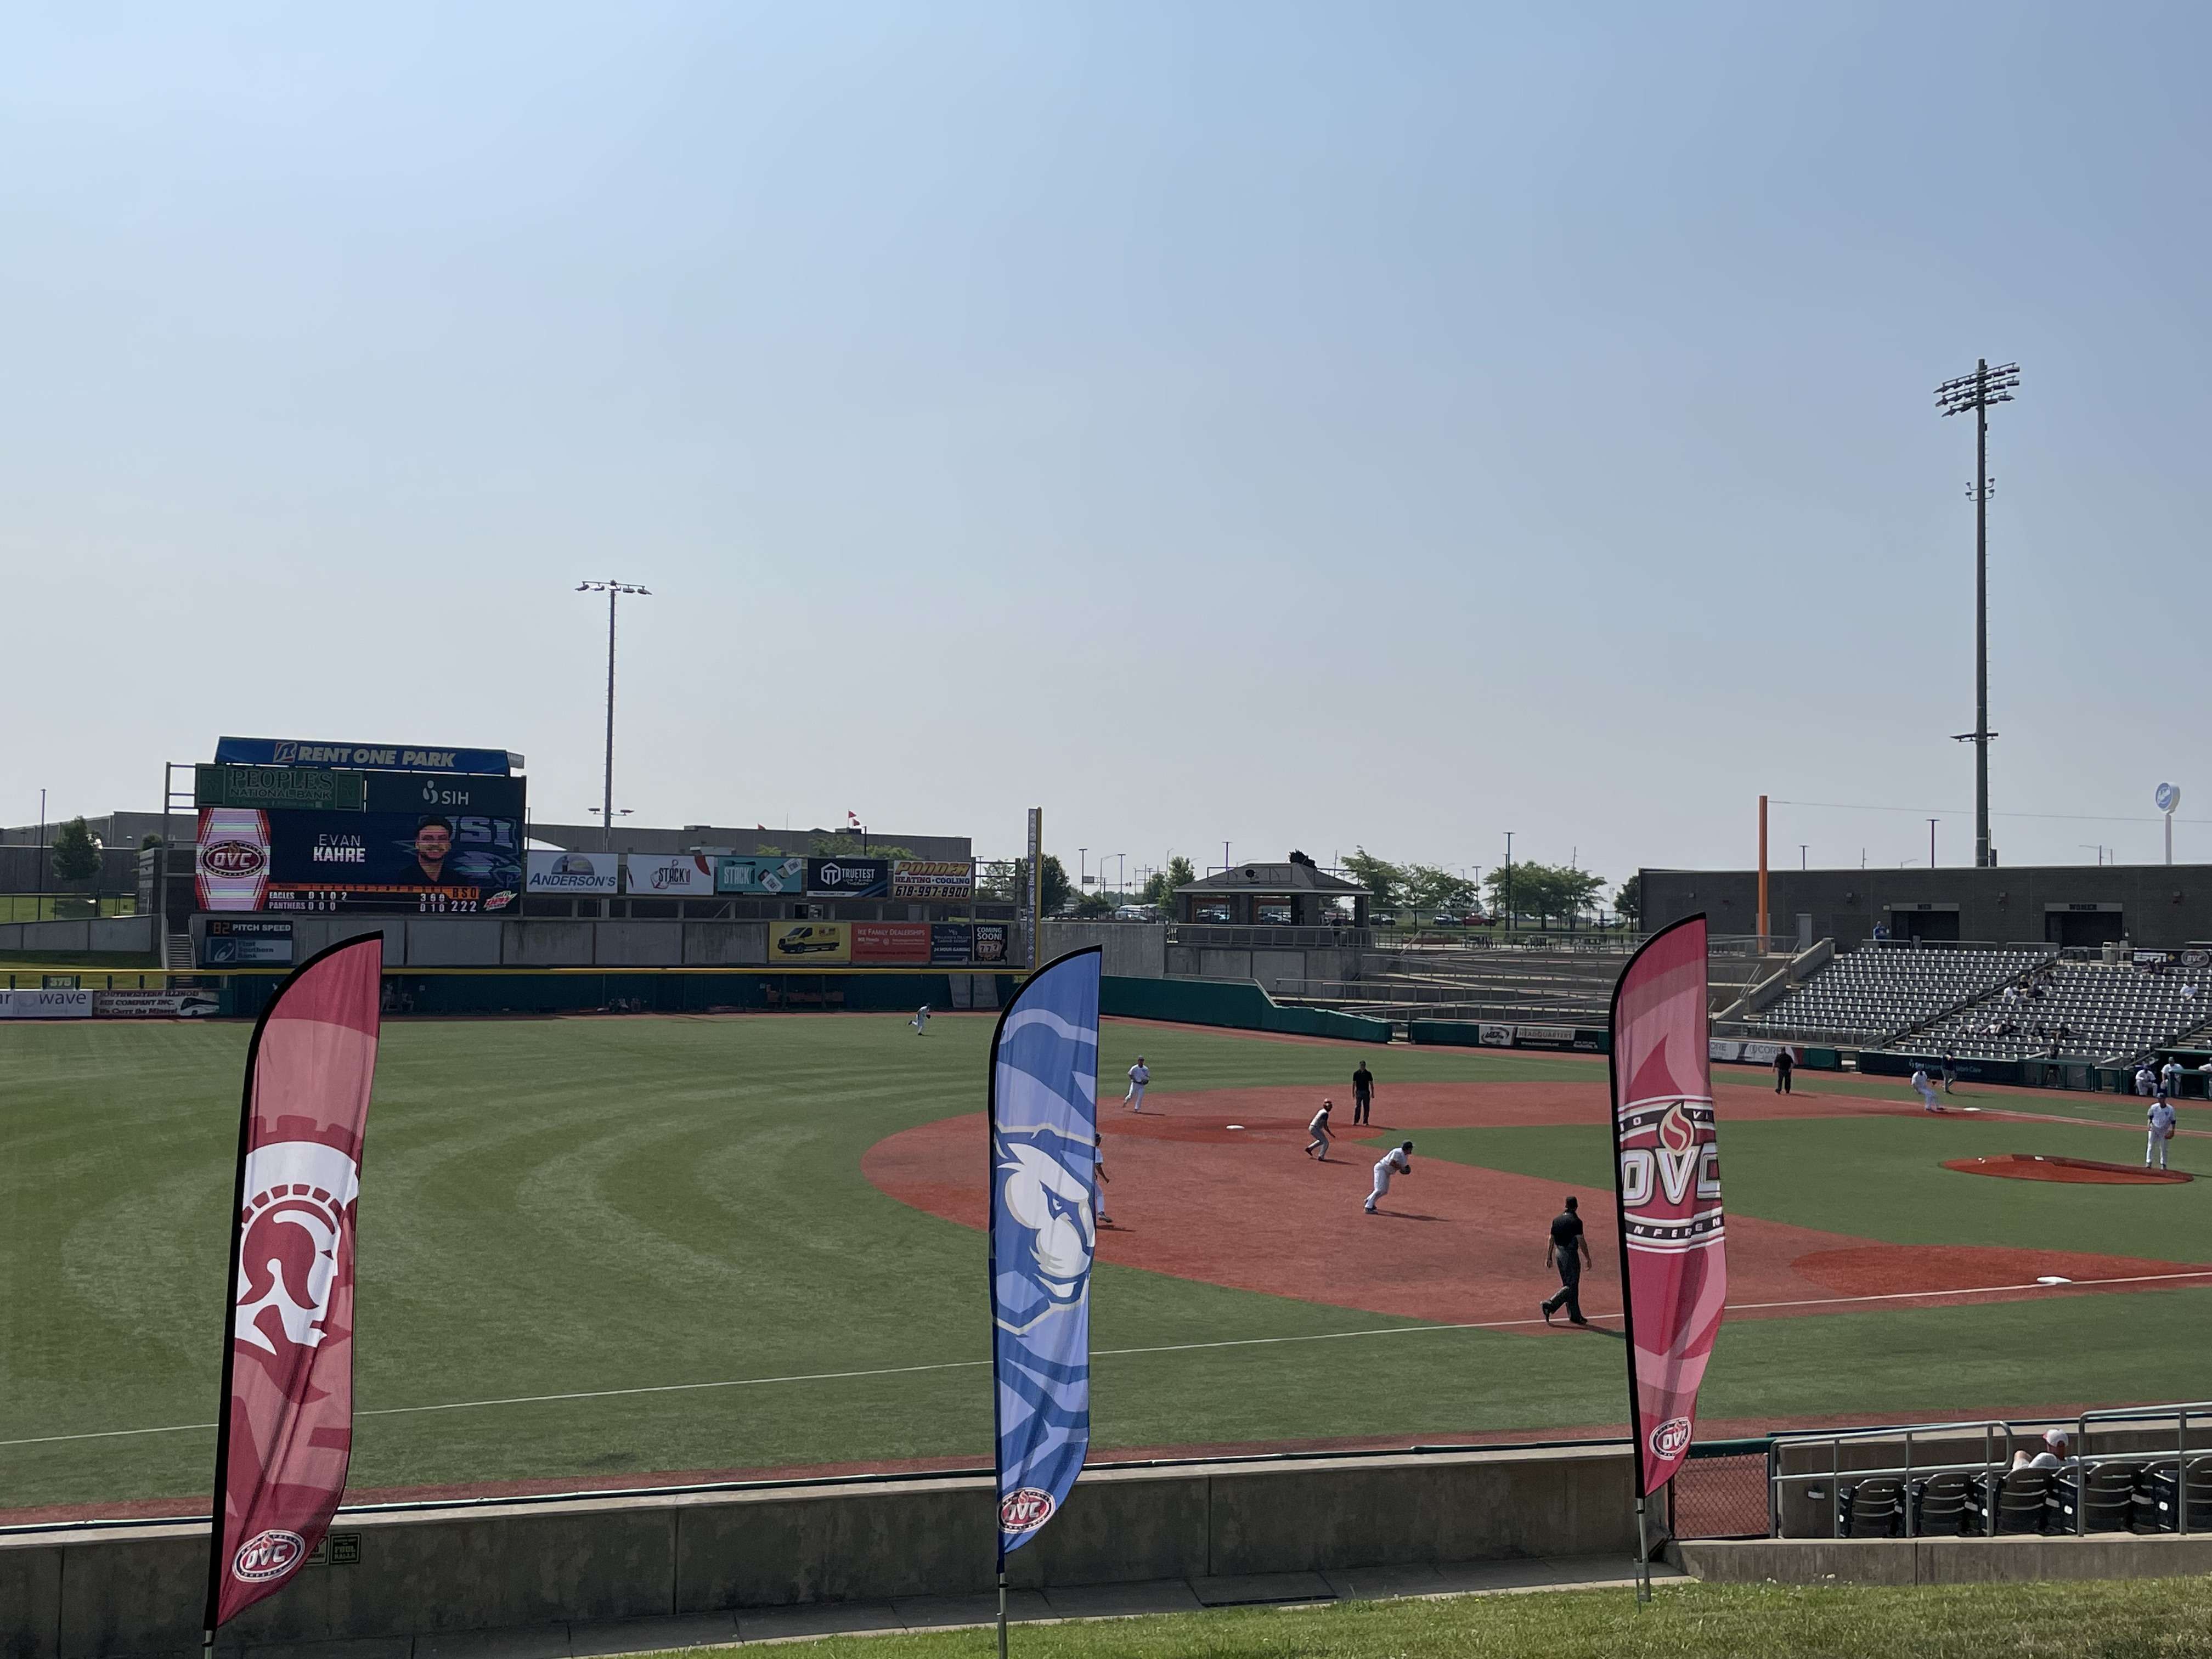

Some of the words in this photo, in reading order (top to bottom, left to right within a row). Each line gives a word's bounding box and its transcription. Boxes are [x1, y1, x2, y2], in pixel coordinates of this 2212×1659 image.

[298, 746, 351, 763] RENT
[353, 748, 397, 765] ONE
[401, 750, 456, 768] PARK
[231, 769, 334, 790] PEOPLES
[229, 788, 294, 798] NATIONAL
[296, 790, 332, 800] BANK
[441, 791, 469, 805] SIH
[319, 834, 361, 847] EVAN
[213, 852, 253, 868] OVC
[313, 847, 366, 862] KAHRE
[842, 868, 875, 878] TRUETEST
[895, 861, 970, 877] PONDER
[529, 872, 616, 887] ANDERSON'S
[320, 891, 325, 900] 1
[330, 891, 336, 900] 0
[341, 892, 347, 901] 2
[420, 894, 426, 902] 3
[308, 902, 314, 911] 0
[319, 902, 324, 911] 0
[330, 902, 336, 911] 0
[213, 922, 230, 934] 82
[40, 992, 86, 1005] wave
[1519, 1030, 1572, 1040] HEADQUARTERS
[1710, 1043, 1726, 1052] ORE
[1621, 1143, 1721, 1206] OVC
[1662, 1428, 1687, 1450] OV
[245, 1544, 288, 1570] OVC
